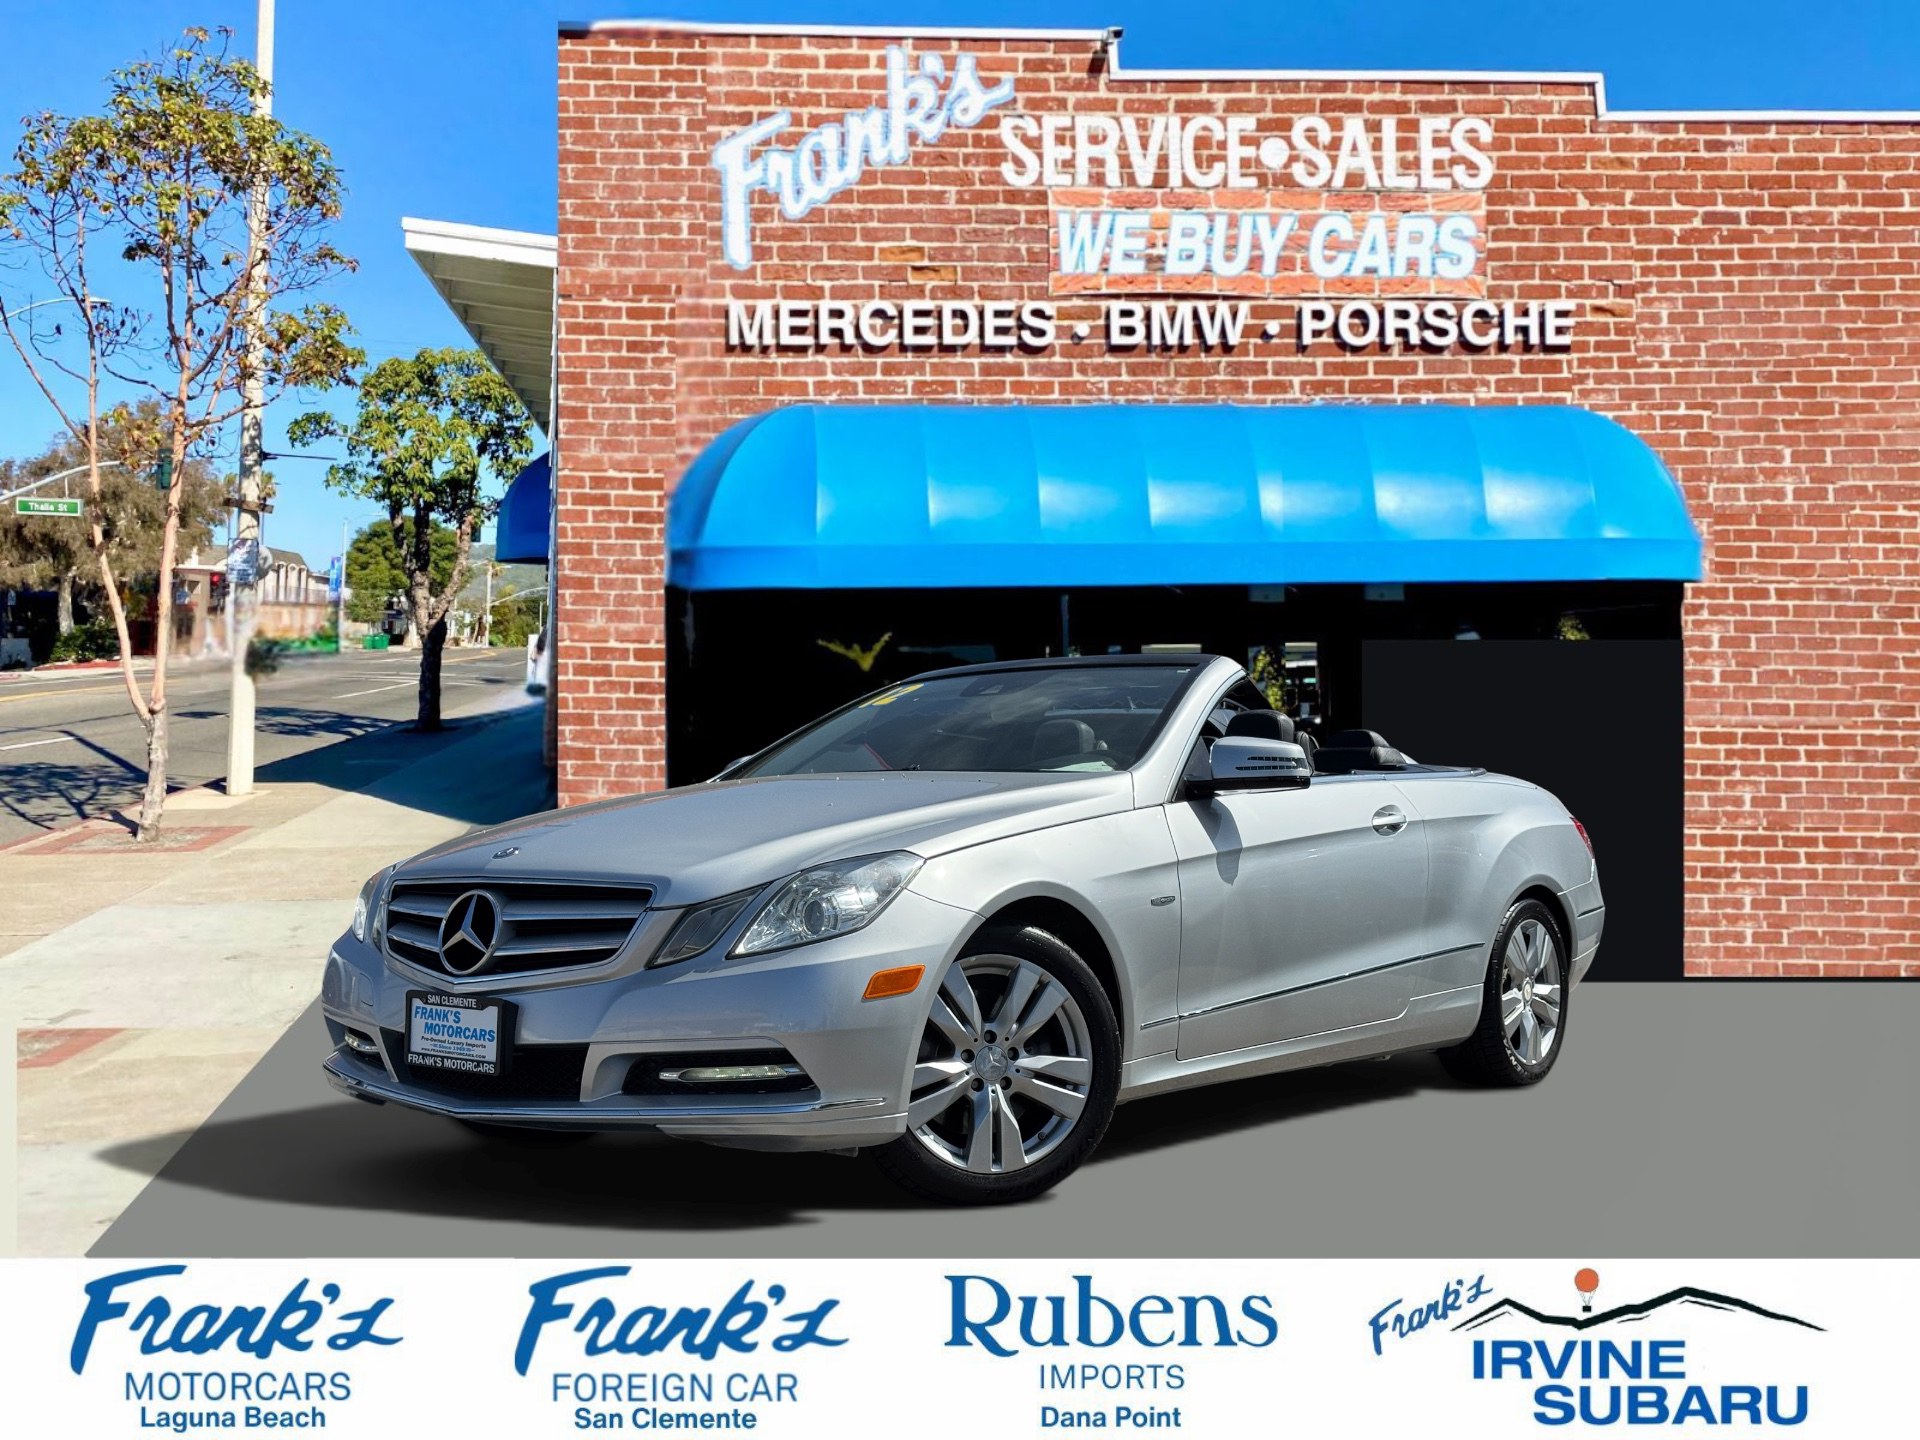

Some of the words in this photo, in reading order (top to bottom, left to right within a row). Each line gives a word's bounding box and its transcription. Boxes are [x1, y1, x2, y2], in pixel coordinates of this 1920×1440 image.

[712, 44, 1015, 270] Frank's
[1056, 211, 1153, 276] WE
[1164, 211, 1298, 277] BUY
[1307, 212, 1479, 279] CARS
[727, 301, 1057, 348] MERCEDES
[1108, 301, 1249, 347] BMW
[1300, 301, 1577, 348] PORSCHE
[57, 503, 68, 512] St
[427, 994, 441, 1003] SAN
[442, 996, 477, 1008] CLEMENTE
[414, 1005, 462, 1024] FRANK'S
[421, 1036, 446, 1044] Pre-Owned
[447, 1038, 465, 1047] Luxury
[465, 1040, 487, 1049] Imports
[423, 1022, 496, 1043] MOTORCARS
[408, 1053, 442, 1067] FRANK'S
[443, 1058, 495, 1074] MOTORCARS
